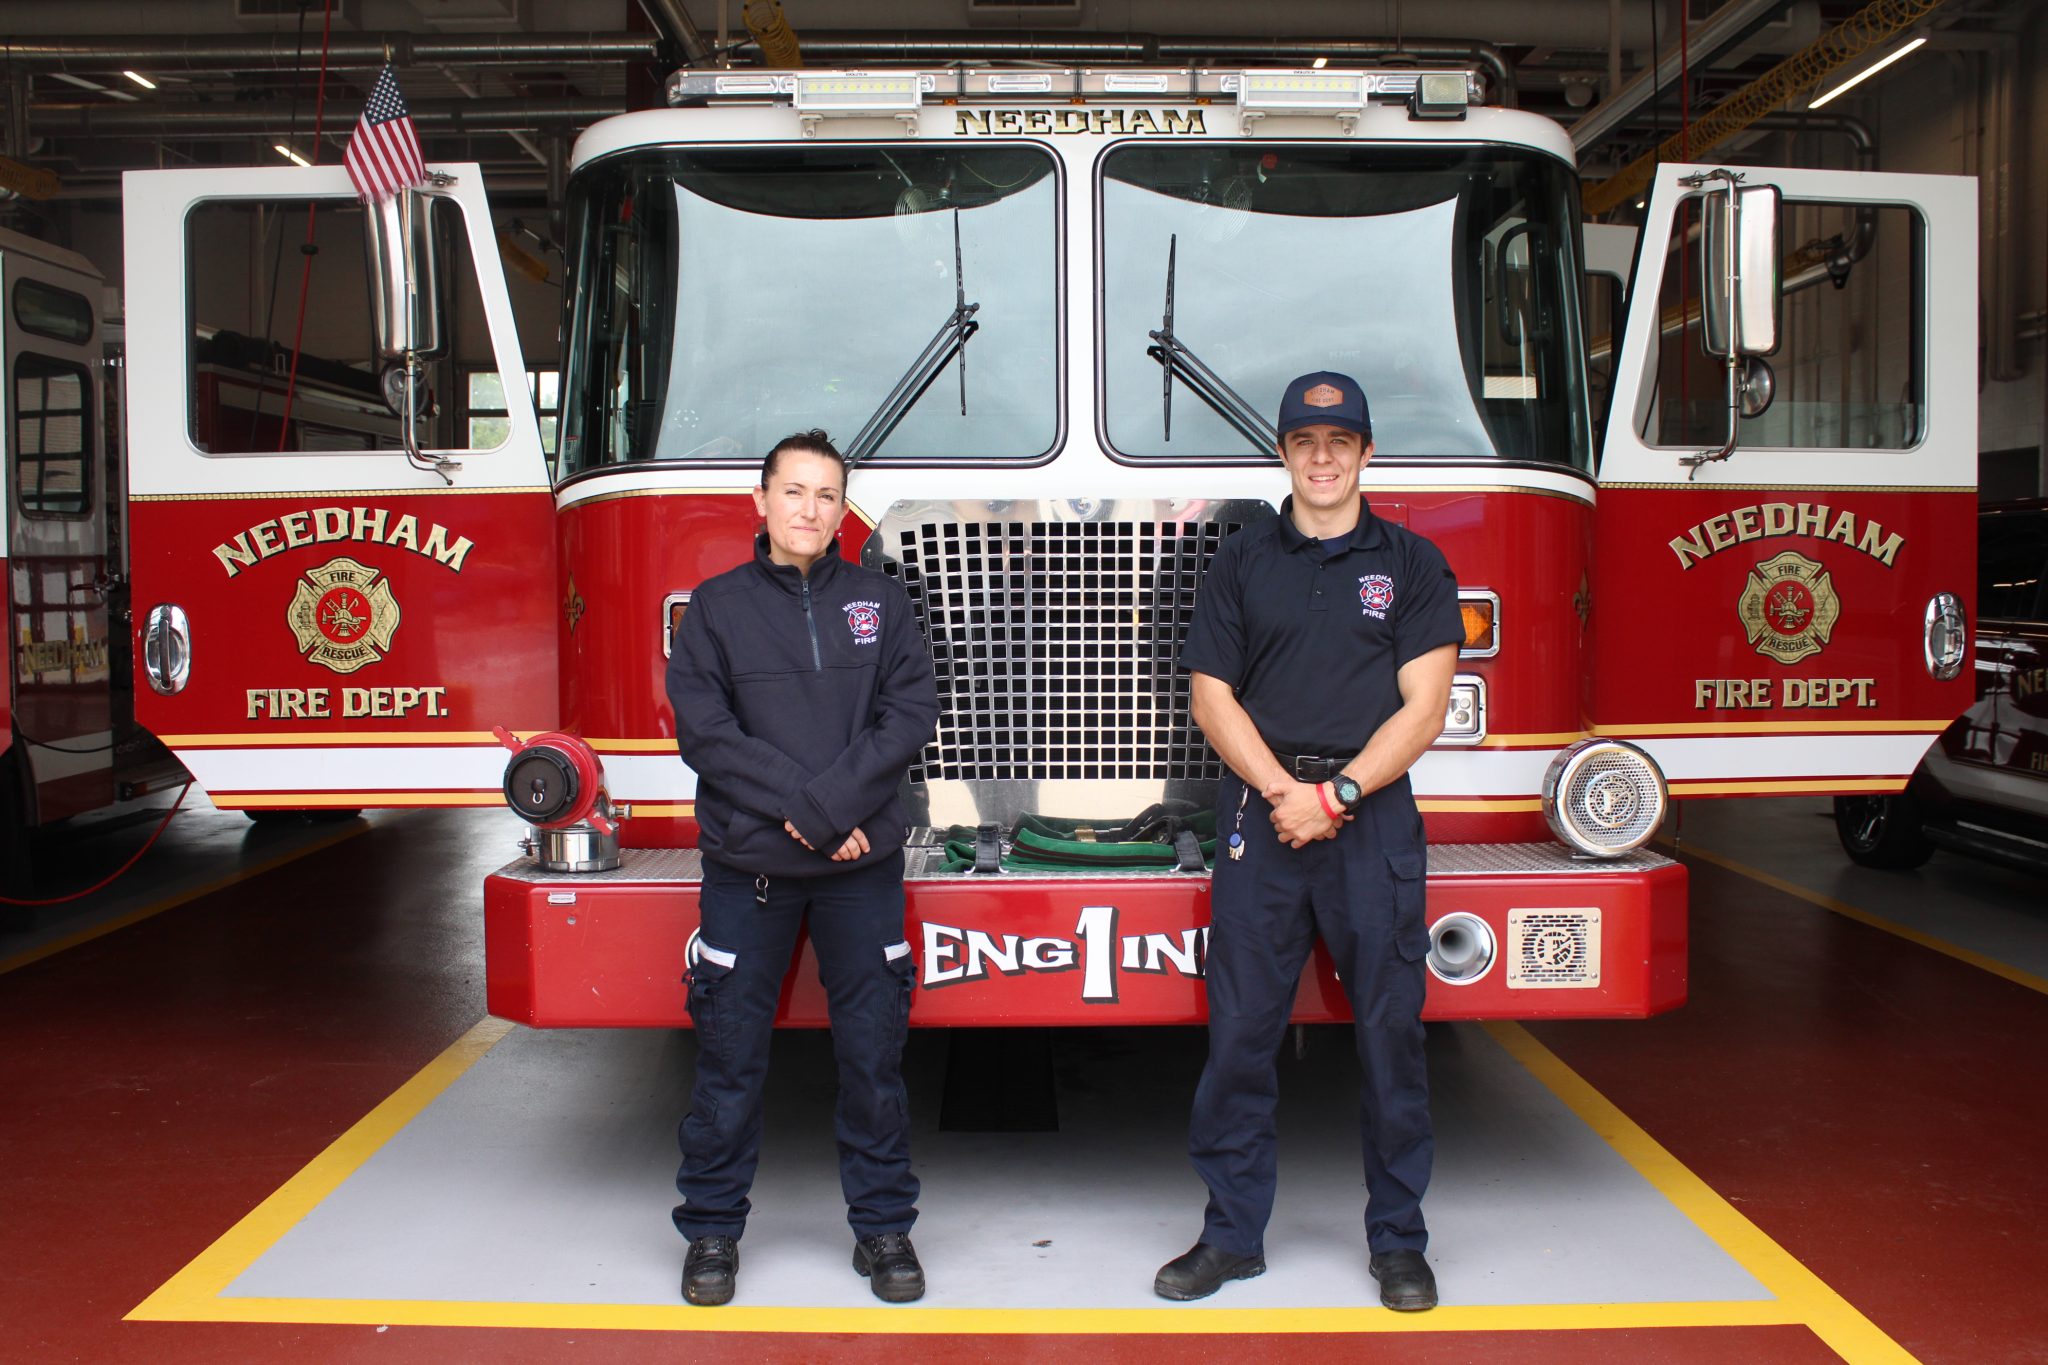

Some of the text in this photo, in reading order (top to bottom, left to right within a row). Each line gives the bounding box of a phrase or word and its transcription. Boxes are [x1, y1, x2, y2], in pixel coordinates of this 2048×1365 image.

[954, 109, 1207, 135] NEEDHAM
[212, 506, 474, 578] NEEDHAM
[1668, 503, 1905, 570] NEEDHAM
[329, 571, 356, 583] FIRE
[1777, 564, 1801, 576] FIRE
[1358, 574, 1394, 588] NEEDHA
[842, 601, 880, 612] NEEDHAM
[1362, 608, 1386, 620] FIRE
[854, 635, 877, 645] FIRE
[1769, 638, 1810, 652] RESCUE
[322, 645, 368, 660] RESCUE
[1695, 678, 1877, 709] FIRE DEPT.
[247, 687, 448, 719] FIRE DEPT.
